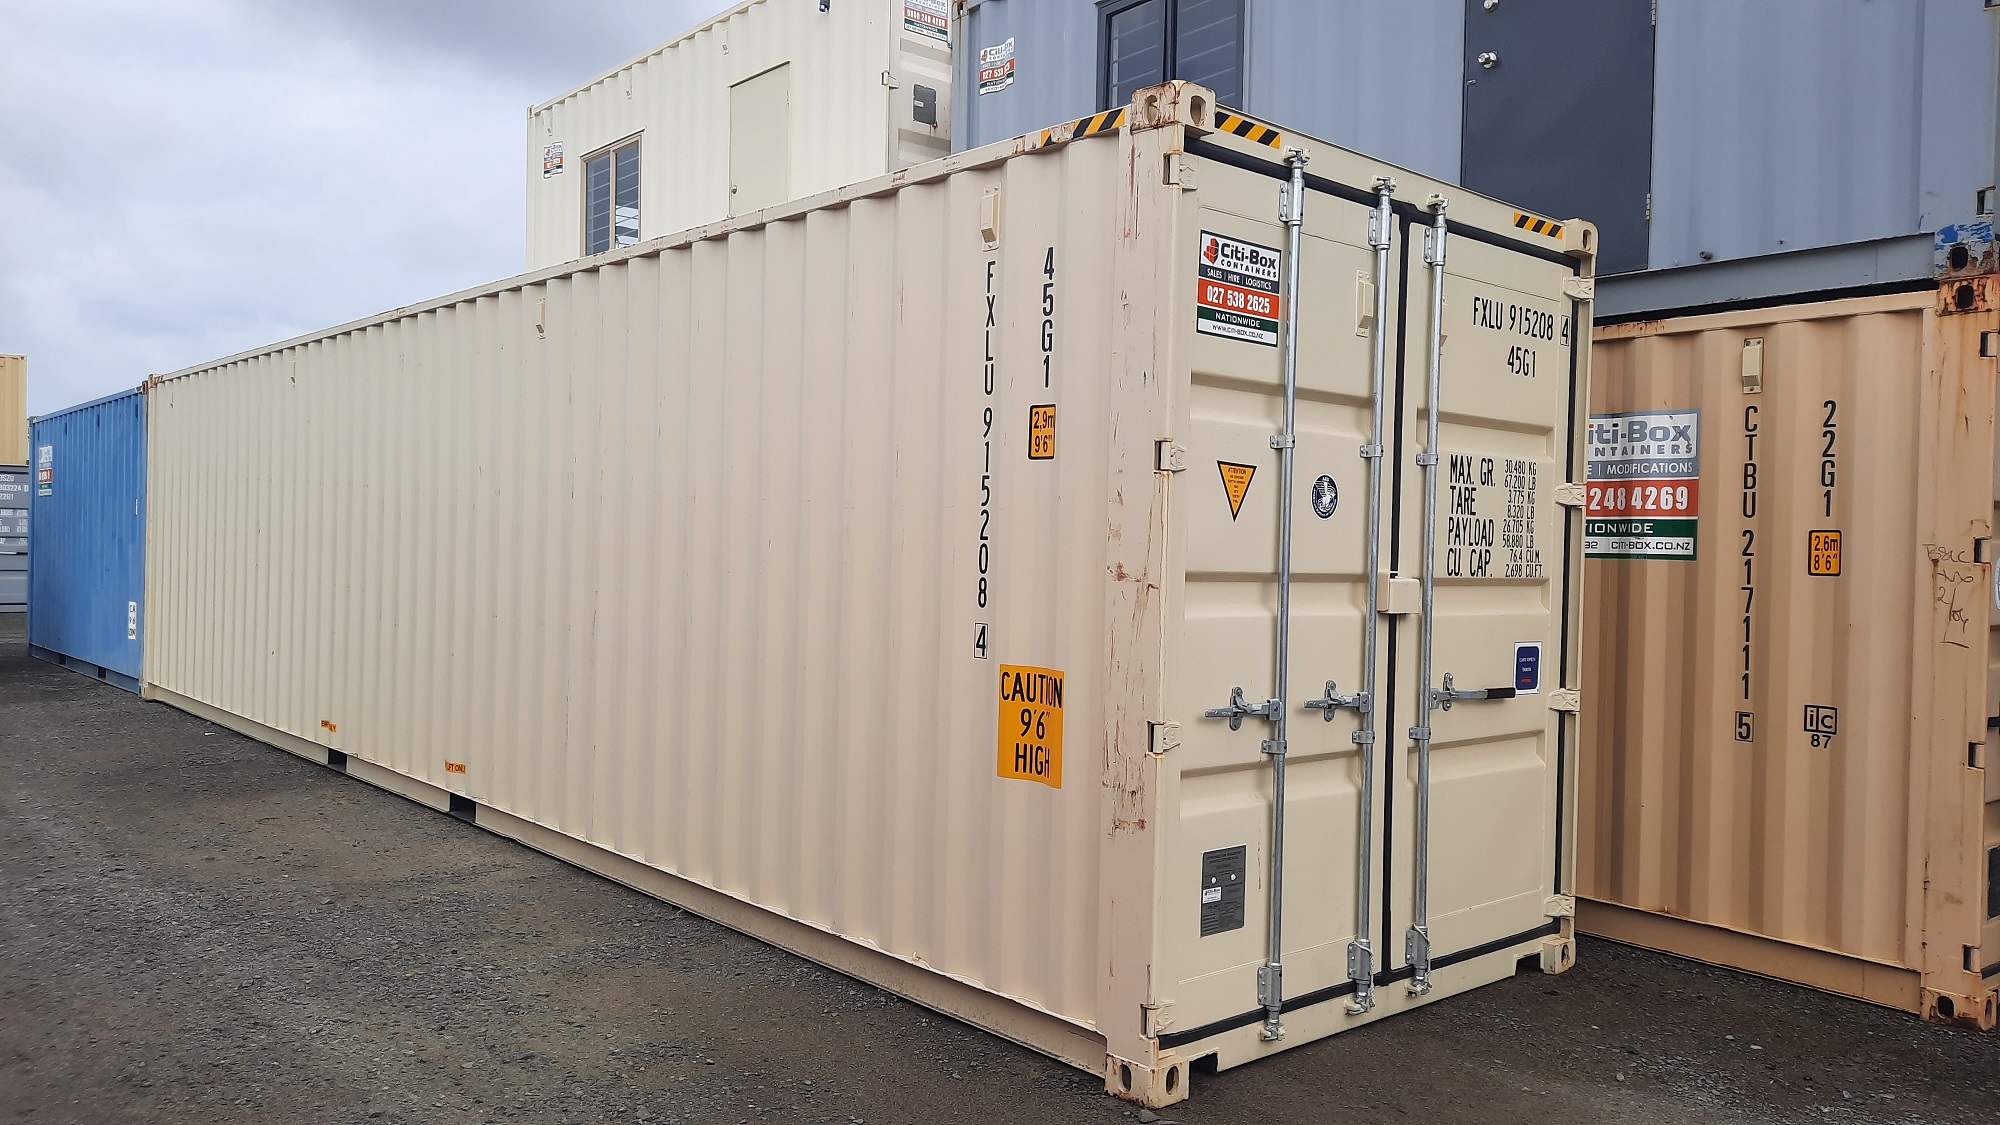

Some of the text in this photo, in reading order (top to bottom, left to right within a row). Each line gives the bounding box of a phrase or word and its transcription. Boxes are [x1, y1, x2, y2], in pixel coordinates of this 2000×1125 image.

[1221, 243, 1276, 269] Citi-Box
[1221, 259, 1276, 278] CONTAINERS
[1207, 268, 1272, 290] SALES HIRE LOGISTICS
[1207, 285, 1270, 314] 027 538 2625
[1041, 246, 1055, 389] 45G1
[1215, 312, 1261, 328] NATIONWIDE
[1473, 296, 1569, 345] FXLU 915208 4
[1507, 345, 1536, 378] 45G1
[1588, 420, 1692, 445] iti-Box
[975, 261, 996, 657] FXLU 915208 4
[1595, 443, 1693, 458] NTAINERS
[1821, 400, 1837, 518] 22G1
[1449, 453, 1475, 486] MAX.
[1480, 457, 1496, 488] GR.
[1528, 461, 1537, 476] KG
[1606, 461, 1693, 475] MODIFICATIONS
[1528, 476, 1536, 491] LB
[1449, 485, 1477, 516] TARE
[1527, 490, 1536, 505] KG
[1589, 485, 1689, 511] 248 4269
[1526, 505, 1535, 520] LB
[1447, 516, 1495, 547] PAYLOAD
[1526, 520, 1535, 534] KG
[1589, 522, 1654, 534] IONWIDE
[1525, 534, 1535, 549] LB
[1611, 541, 1691, 551] CITI-BOX.CO.NZ
[1446, 547, 1463, 577] CU.
[1469, 548, 1493, 578] CAP.
[1738, 405, 1758, 740] CTBU 217111 5
[1001, 671, 1063, 709] CAUTION
[1810, 733, 1832, 749] 87
[1014, 742, 1050, 779] HIGH
